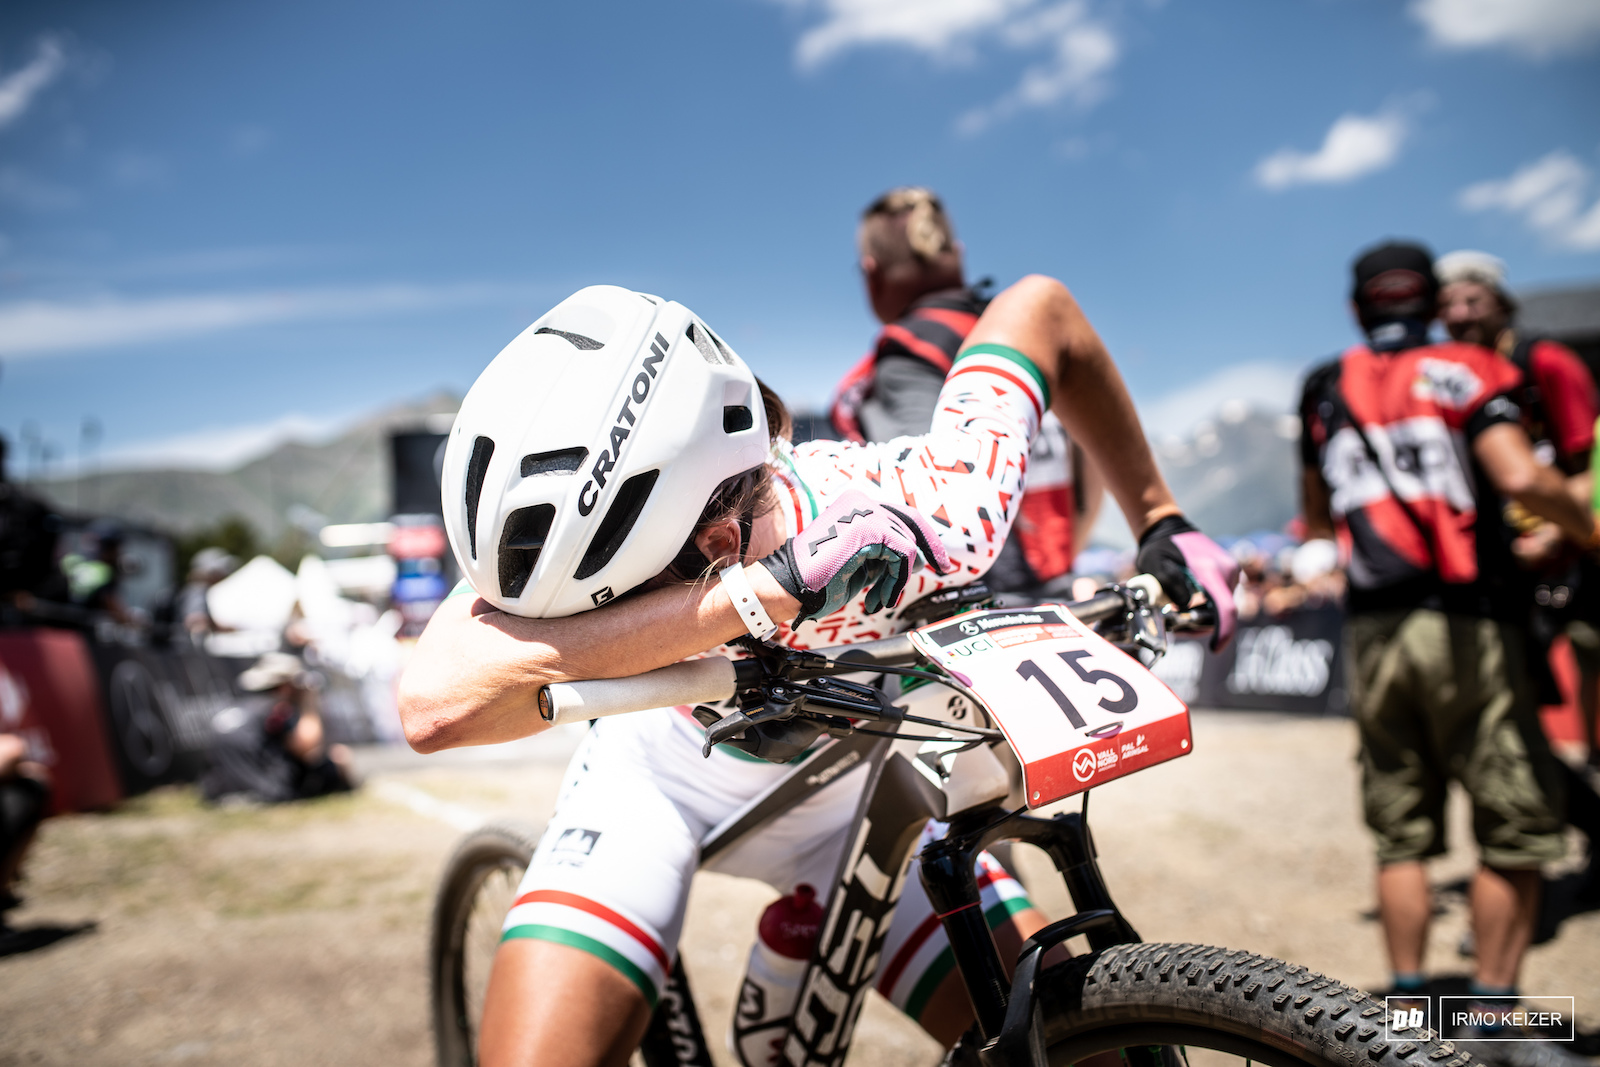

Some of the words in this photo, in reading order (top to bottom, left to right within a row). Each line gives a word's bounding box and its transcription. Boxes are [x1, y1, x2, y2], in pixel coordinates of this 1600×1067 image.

[578, 332, 671, 517] CRATONI
[954, 639, 994, 657] UCI
[1016, 650, 1139, 730] 15
